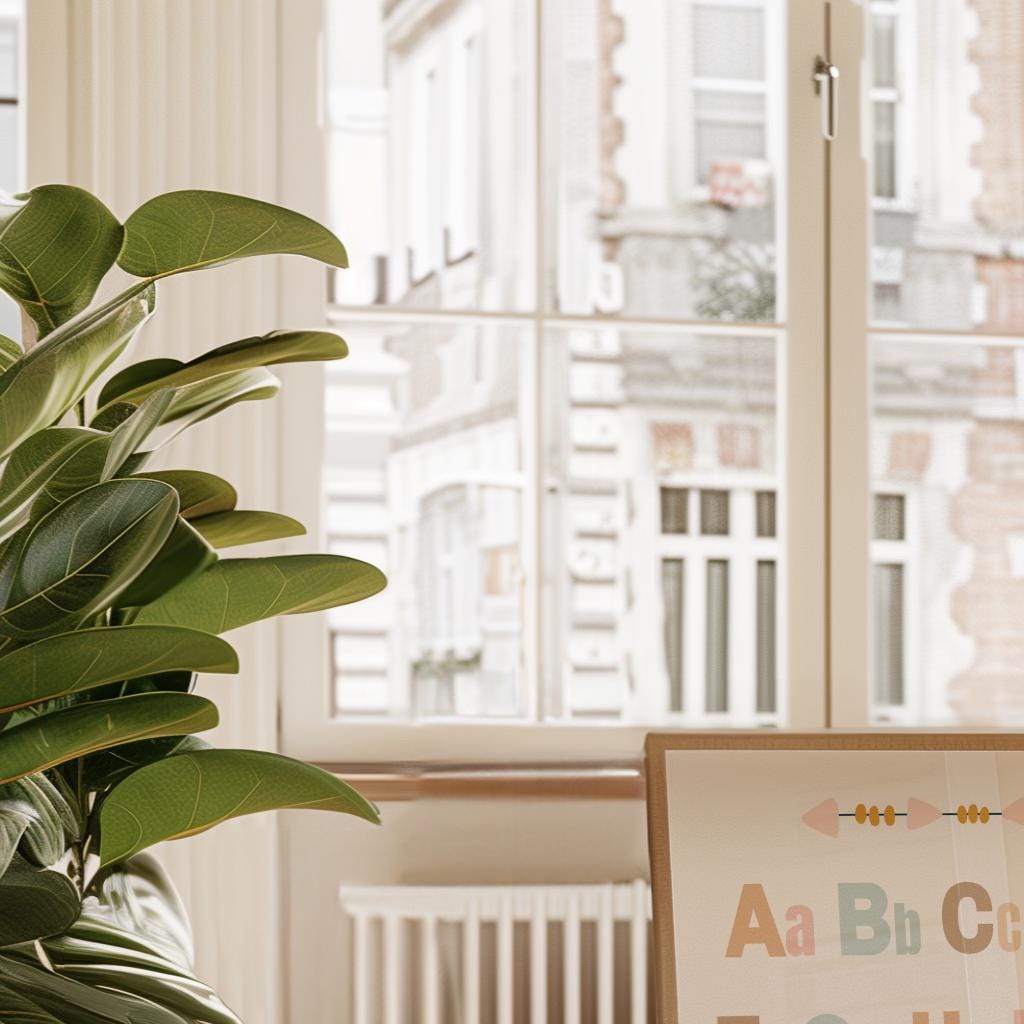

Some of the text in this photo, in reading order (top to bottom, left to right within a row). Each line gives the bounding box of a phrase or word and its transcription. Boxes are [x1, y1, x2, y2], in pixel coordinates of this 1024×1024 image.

[725, 883, 815, 957] Aa
[837, 882, 921, 955] Bb
[941, 881, 1021, 954] Cc
